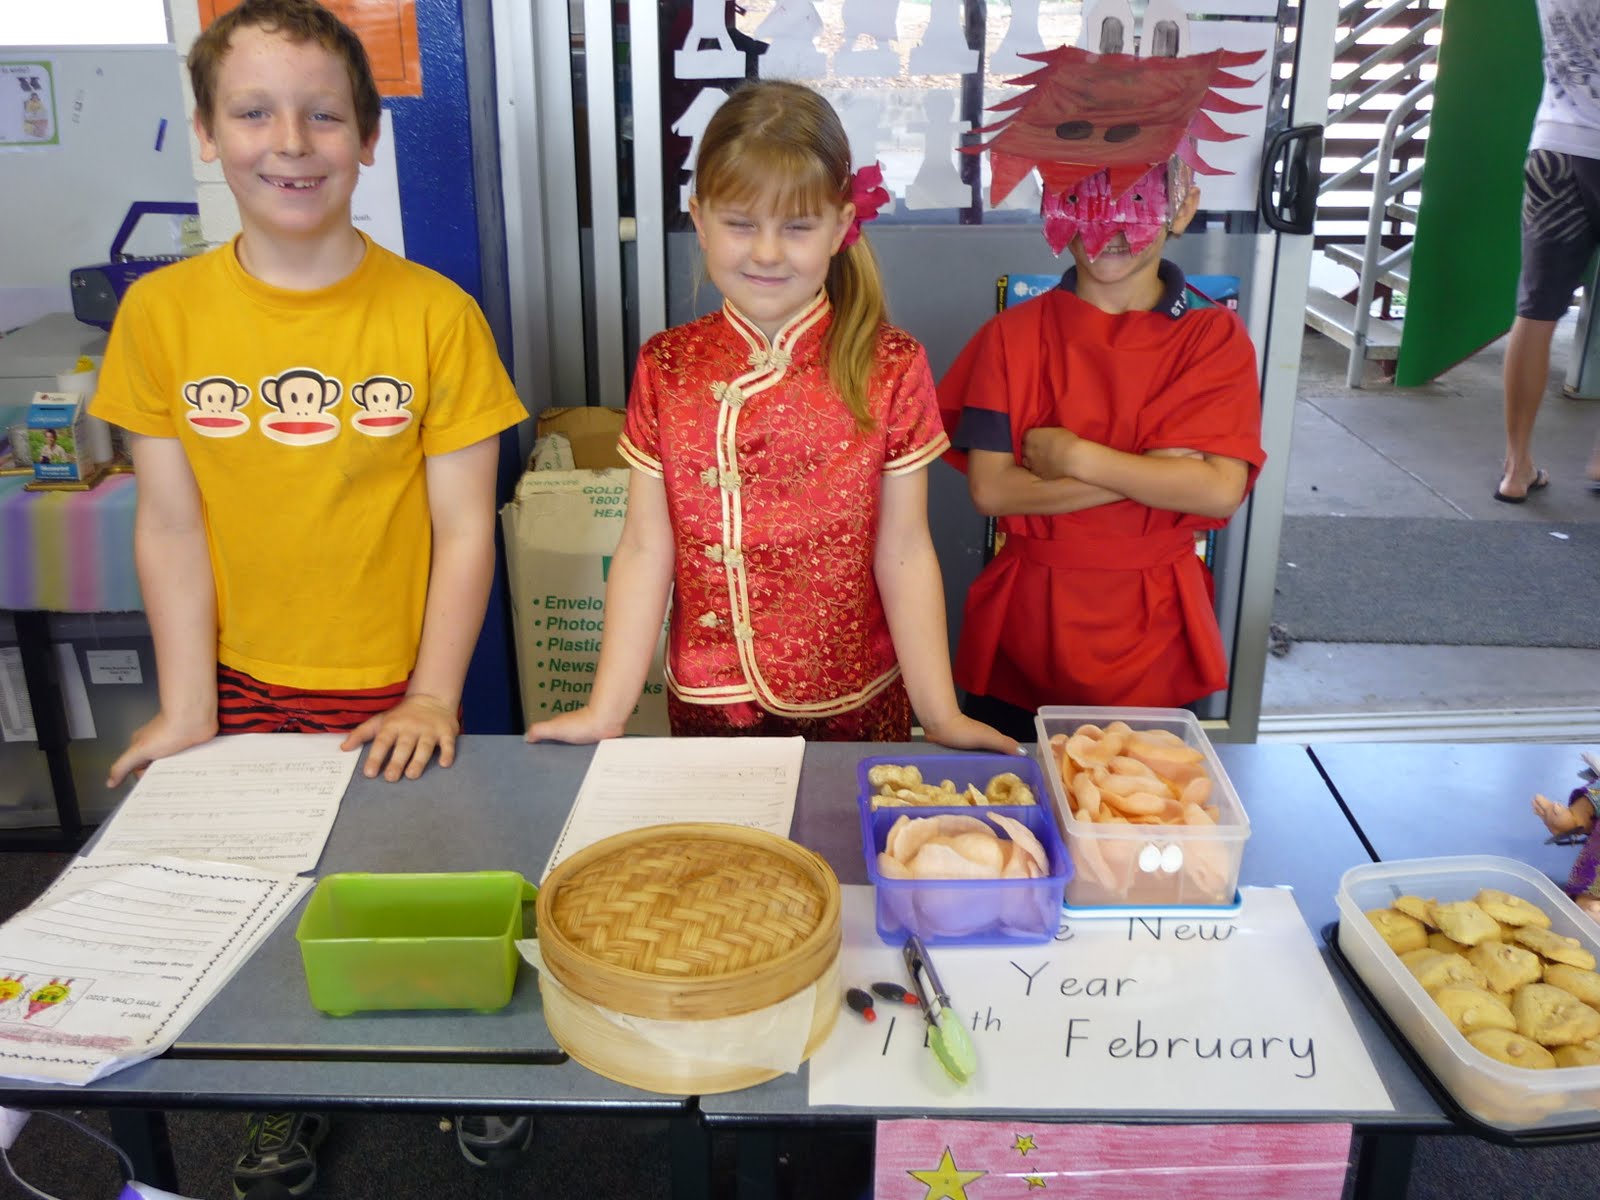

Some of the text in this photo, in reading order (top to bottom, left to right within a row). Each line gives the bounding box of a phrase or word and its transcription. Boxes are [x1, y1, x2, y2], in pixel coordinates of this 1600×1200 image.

[590, 496, 620, 505] 1800
[593, 509, 625, 518] HEA
[545, 595, 603, 611] Envelo
[546, 616, 604, 632] Photoc
[549, 658, 597, 673] News
[550, 678, 592, 693] Phon
[1128, 917, 1238, 941] New
[1010, 960, 1137, 997] Year
[129, 1012, 152, 1020] Year
[1065, 1018, 1317, 1079] February
